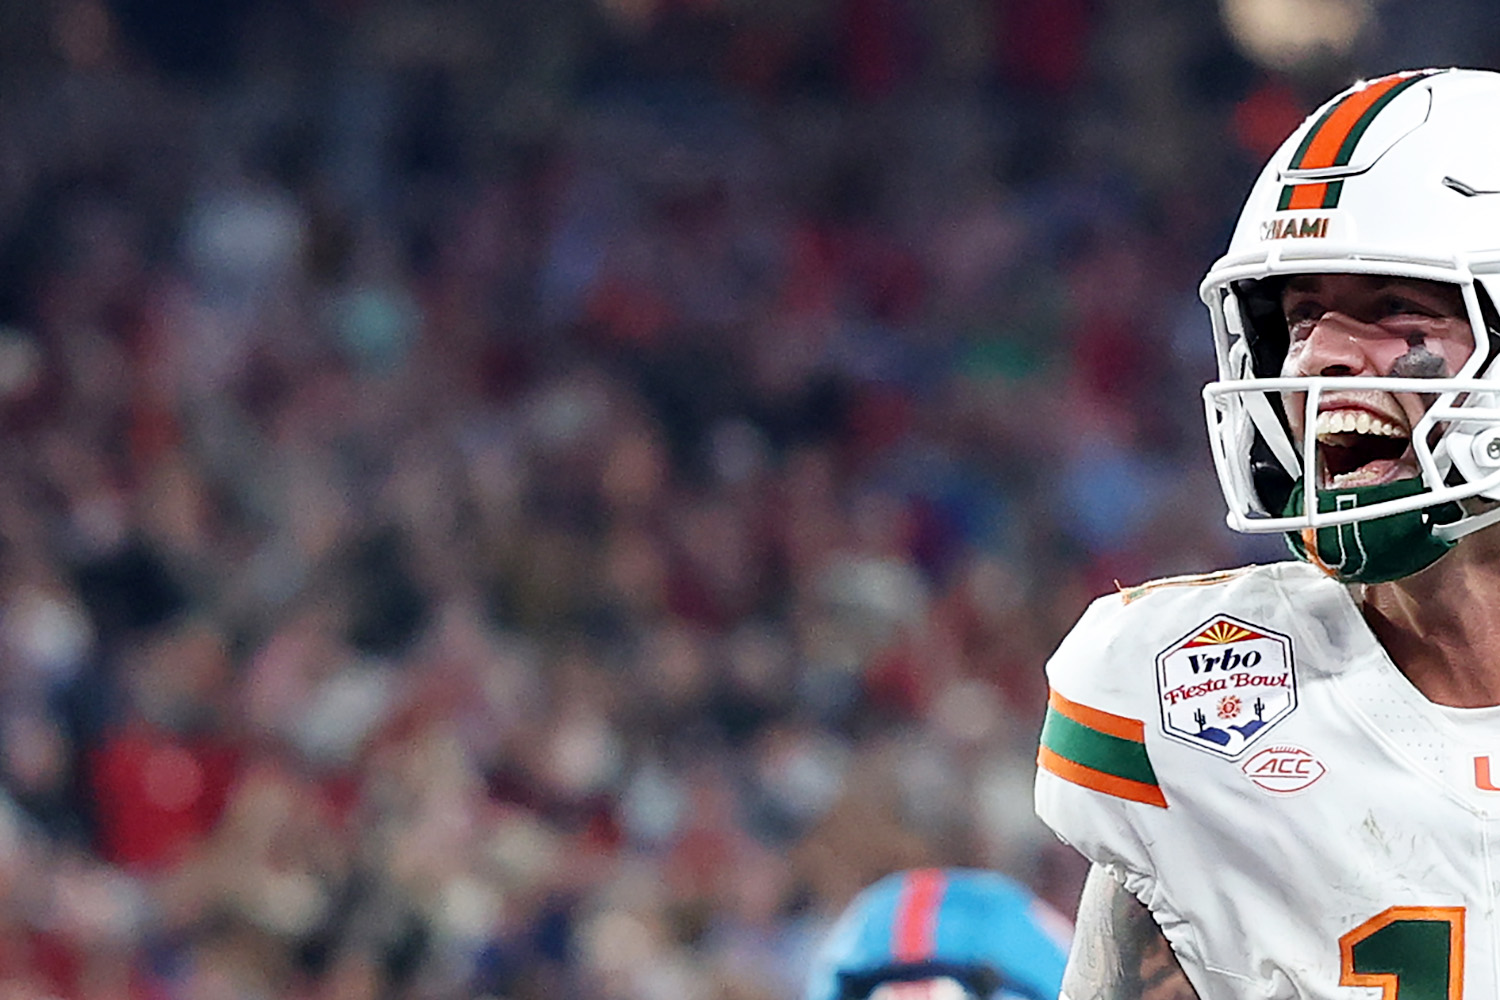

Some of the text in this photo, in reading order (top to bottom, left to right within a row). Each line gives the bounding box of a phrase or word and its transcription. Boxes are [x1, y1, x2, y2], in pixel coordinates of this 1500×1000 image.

[1260, 217, 1330, 241] MIAMI
[1188, 647, 1262, 674] Vrbo
[1163, 672, 1289, 705] Fiesta Bowl
[1255, 758, 1312, 774] ACC
